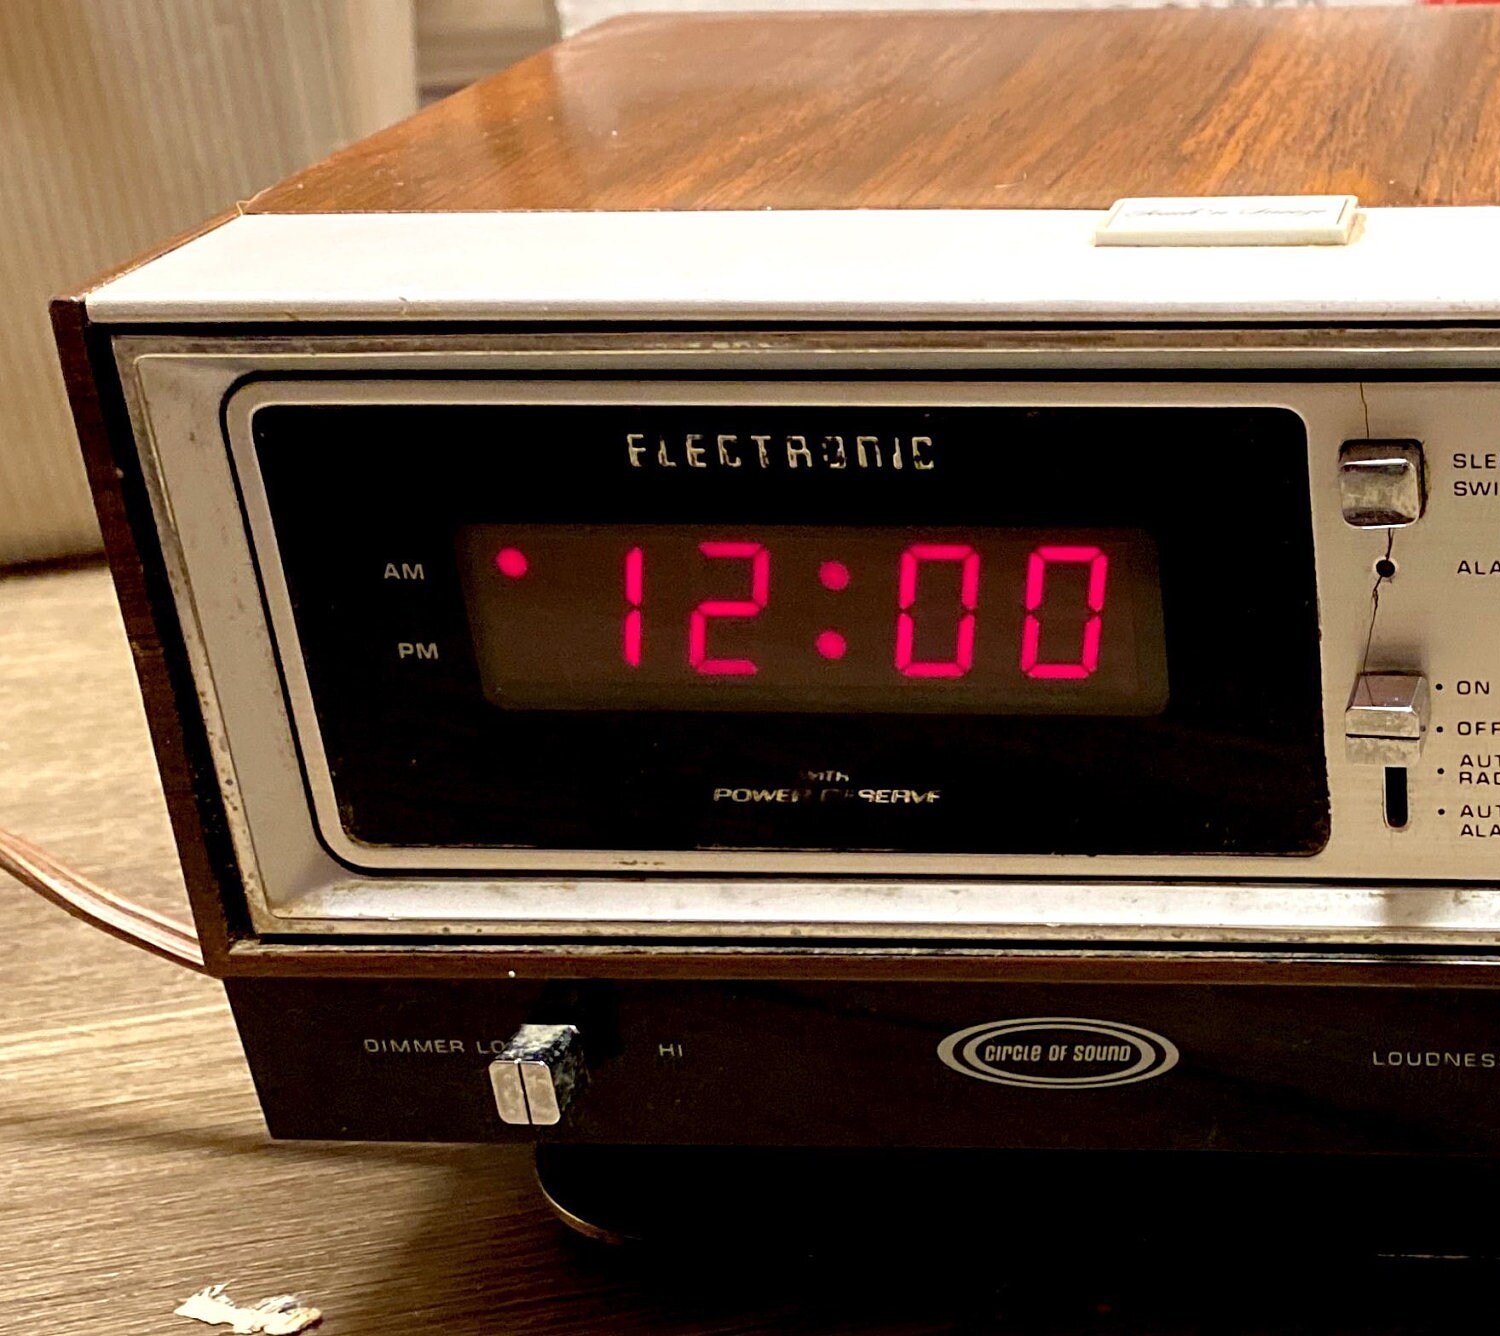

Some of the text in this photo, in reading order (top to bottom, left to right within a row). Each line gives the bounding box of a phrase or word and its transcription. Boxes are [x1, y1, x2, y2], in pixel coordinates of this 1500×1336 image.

[626, 433, 935, 470] ELECTRONIC
[383, 562, 425, 580] AM
[623, 541, 1109, 680] 12:00
[397, 642, 439, 660] PM
[1456, 680, 1490, 696] ON
[363, 1038, 509, 1056] DIMMER LO
[658, 1043, 683, 1057] HI
[1048, 1044, 1069, 1062] OF
